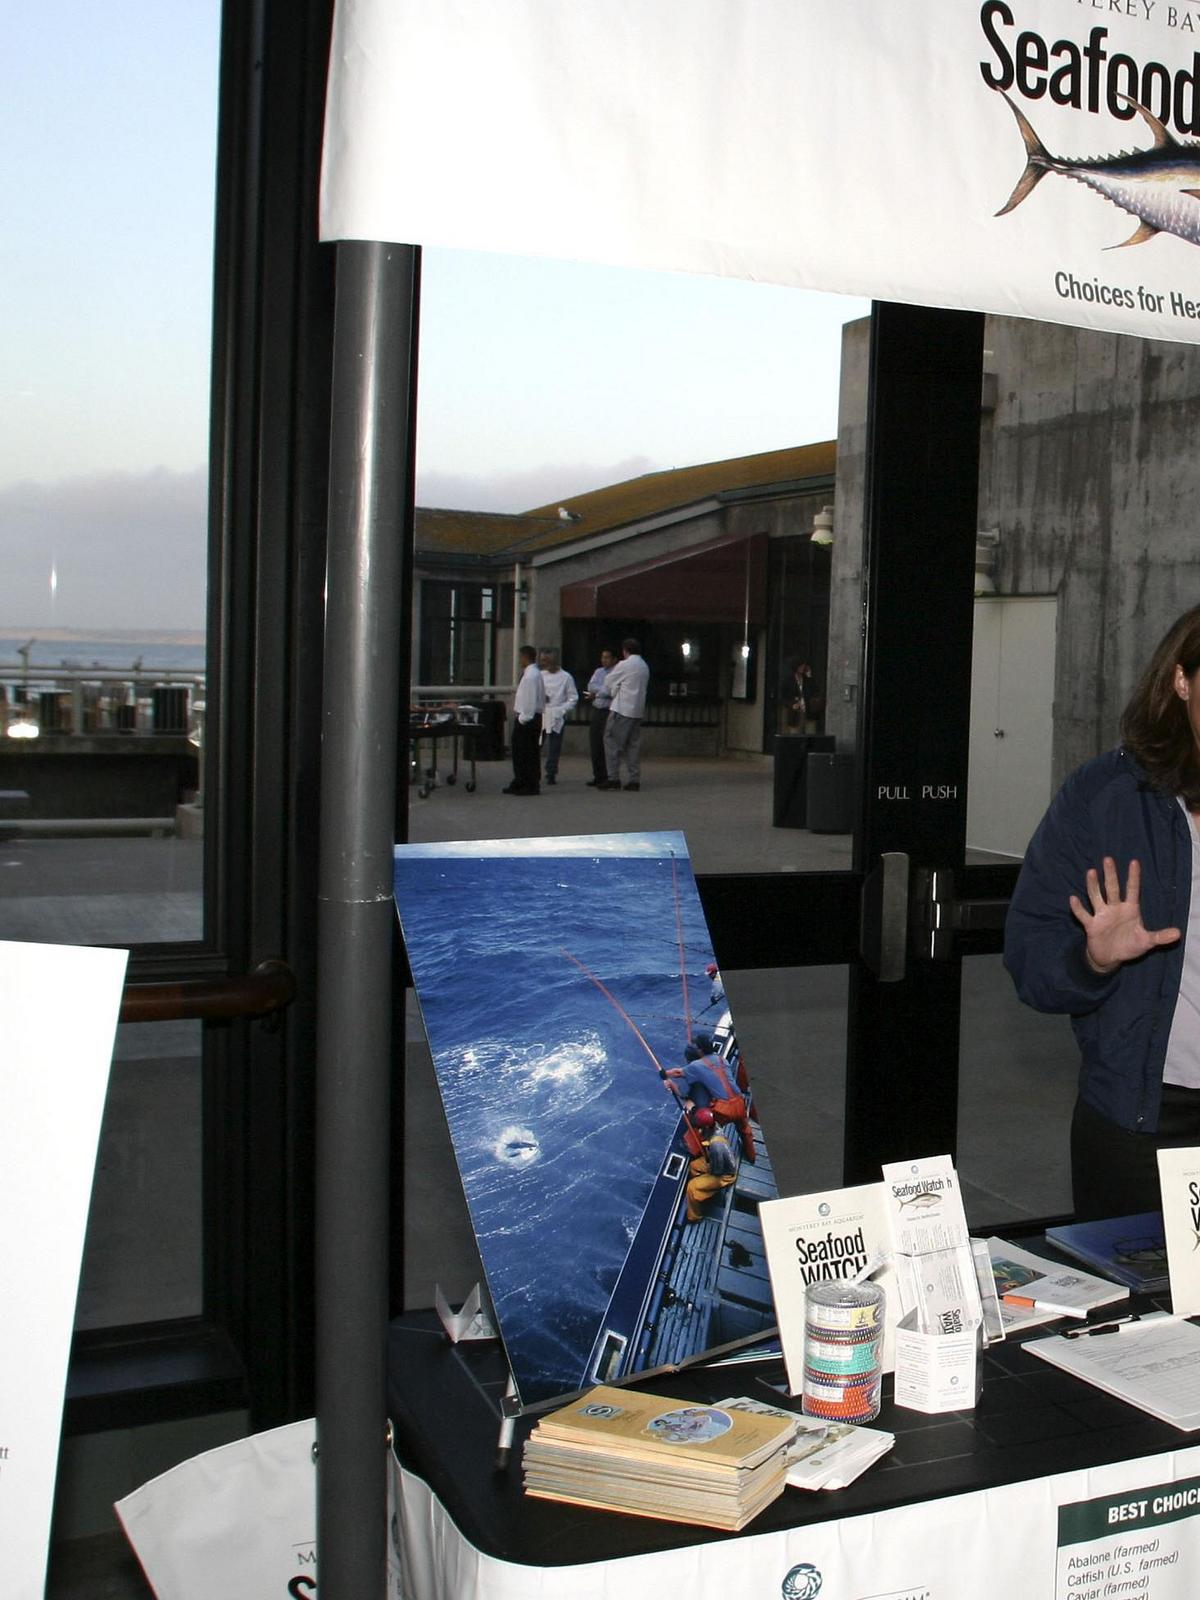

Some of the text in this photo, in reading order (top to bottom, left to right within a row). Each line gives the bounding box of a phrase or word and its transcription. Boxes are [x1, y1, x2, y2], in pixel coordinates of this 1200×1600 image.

[1054, 271, 1135, 310] Choices
[1137, 286, 1165, 314] for
[878, 785, 957, 800] PULL PUSH
[892, 1181, 922, 1198] Seafood
[921, 1177, 945, 1193] Watch
[796, 1226, 866, 1265] Seafood
[1108, 1500, 1148, 1524] BEST
[1067, 1538, 1160, 1570] Abalone (farmed)
[1067, 1550, 1179, 1587] Catfish (U.S. farmed)
[1066, 1587, 1102, 1600] Caviar
[1103, 1575, 1150, 1597] (farmed)
